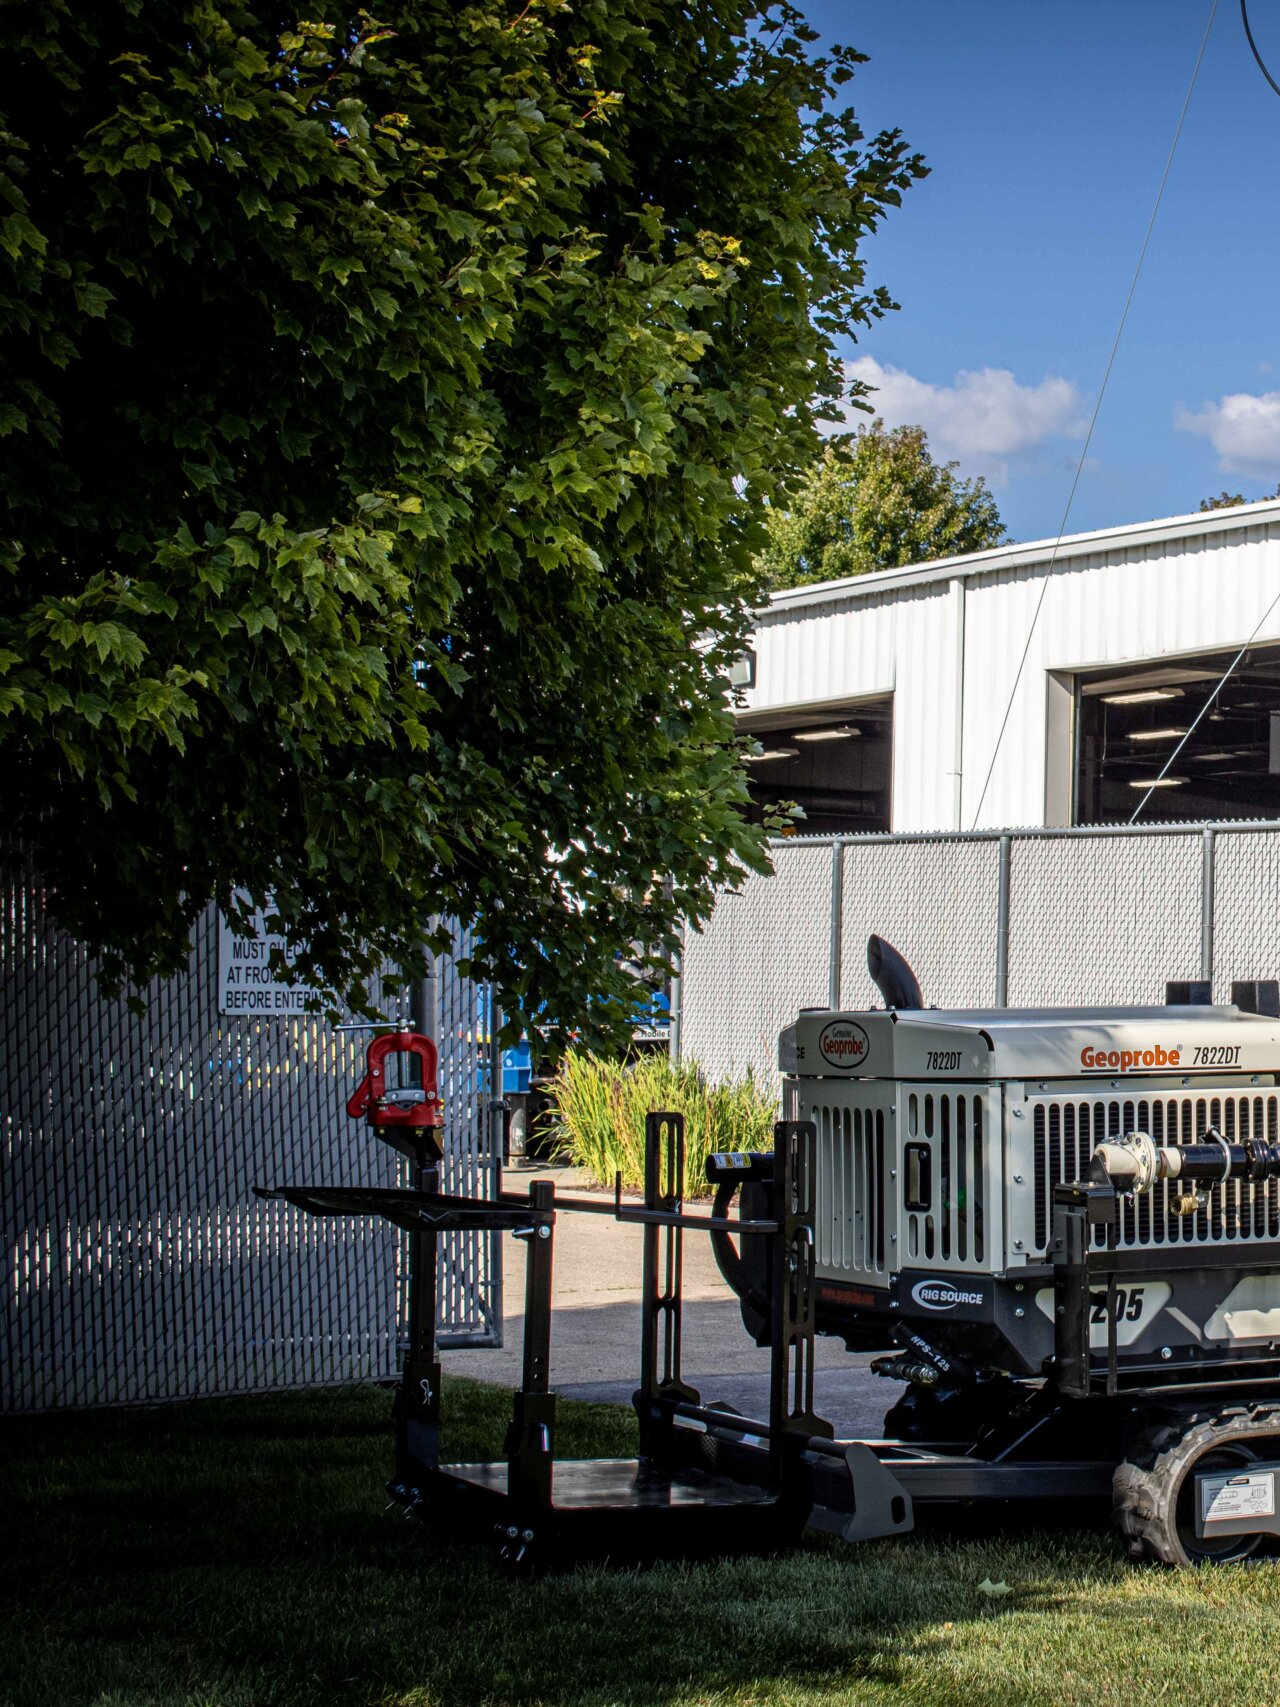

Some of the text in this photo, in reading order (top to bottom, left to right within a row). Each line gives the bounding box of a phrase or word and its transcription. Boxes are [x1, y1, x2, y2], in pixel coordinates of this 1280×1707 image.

[232, 941, 266, 960] MUST
[226, 966, 242, 984] AT
[245, 966, 279, 984] FRO
[226, 990, 272, 1009] BEFORE
[832, 1027, 852, 1038] Genuine
[926, 1051, 962, 1071] 7822DT
[1192, 1046, 1242, 1066] 7822DT
[921, 1289, 984, 1305] RIG SOURCE
[910, 1335, 951, 1372] NPS-125
